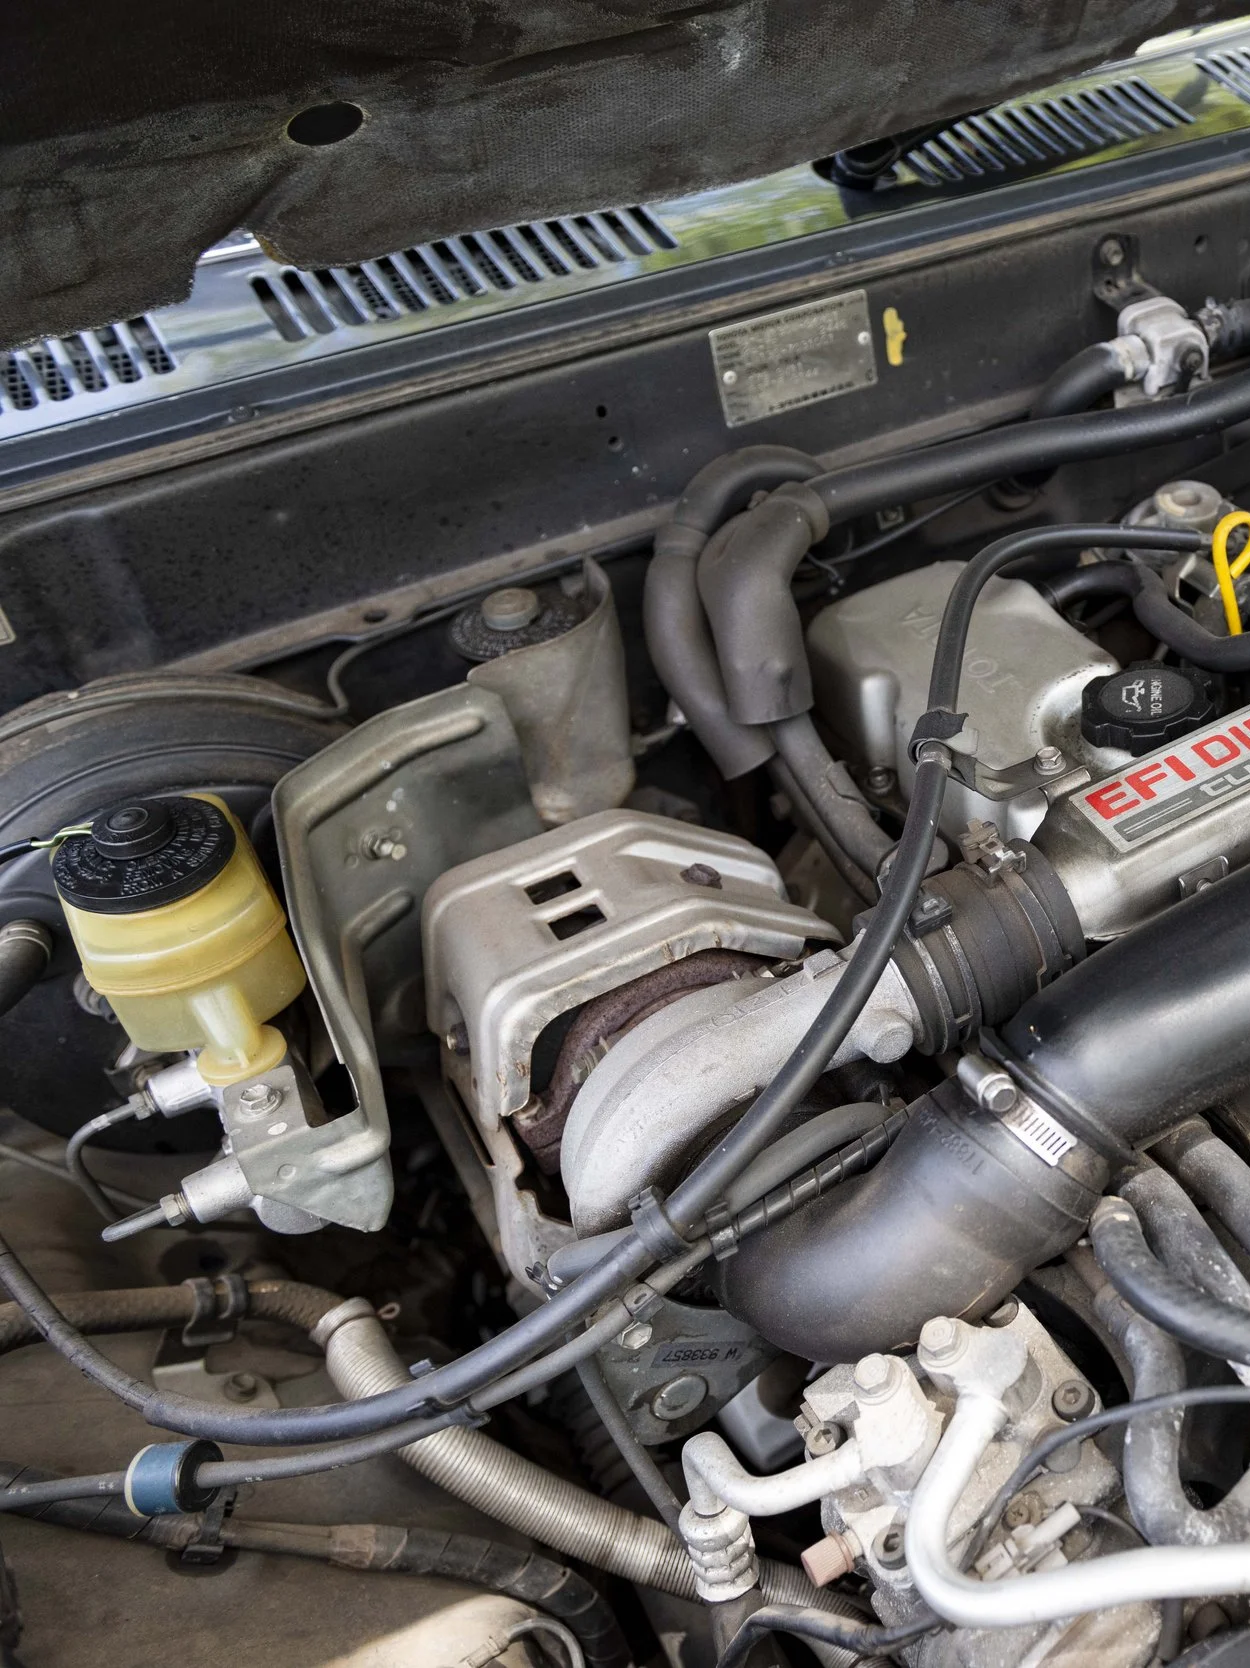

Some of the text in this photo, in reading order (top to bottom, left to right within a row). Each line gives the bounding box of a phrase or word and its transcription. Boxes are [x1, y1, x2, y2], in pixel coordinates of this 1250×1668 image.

[900, 604, 1015, 694] TOTA
[1150, 702, 1164, 717] OIL
[1085, 754, 1197, 820] EFI
[172, 869, 185, 880] A
[662, 1348, 720, 1363] 933857
